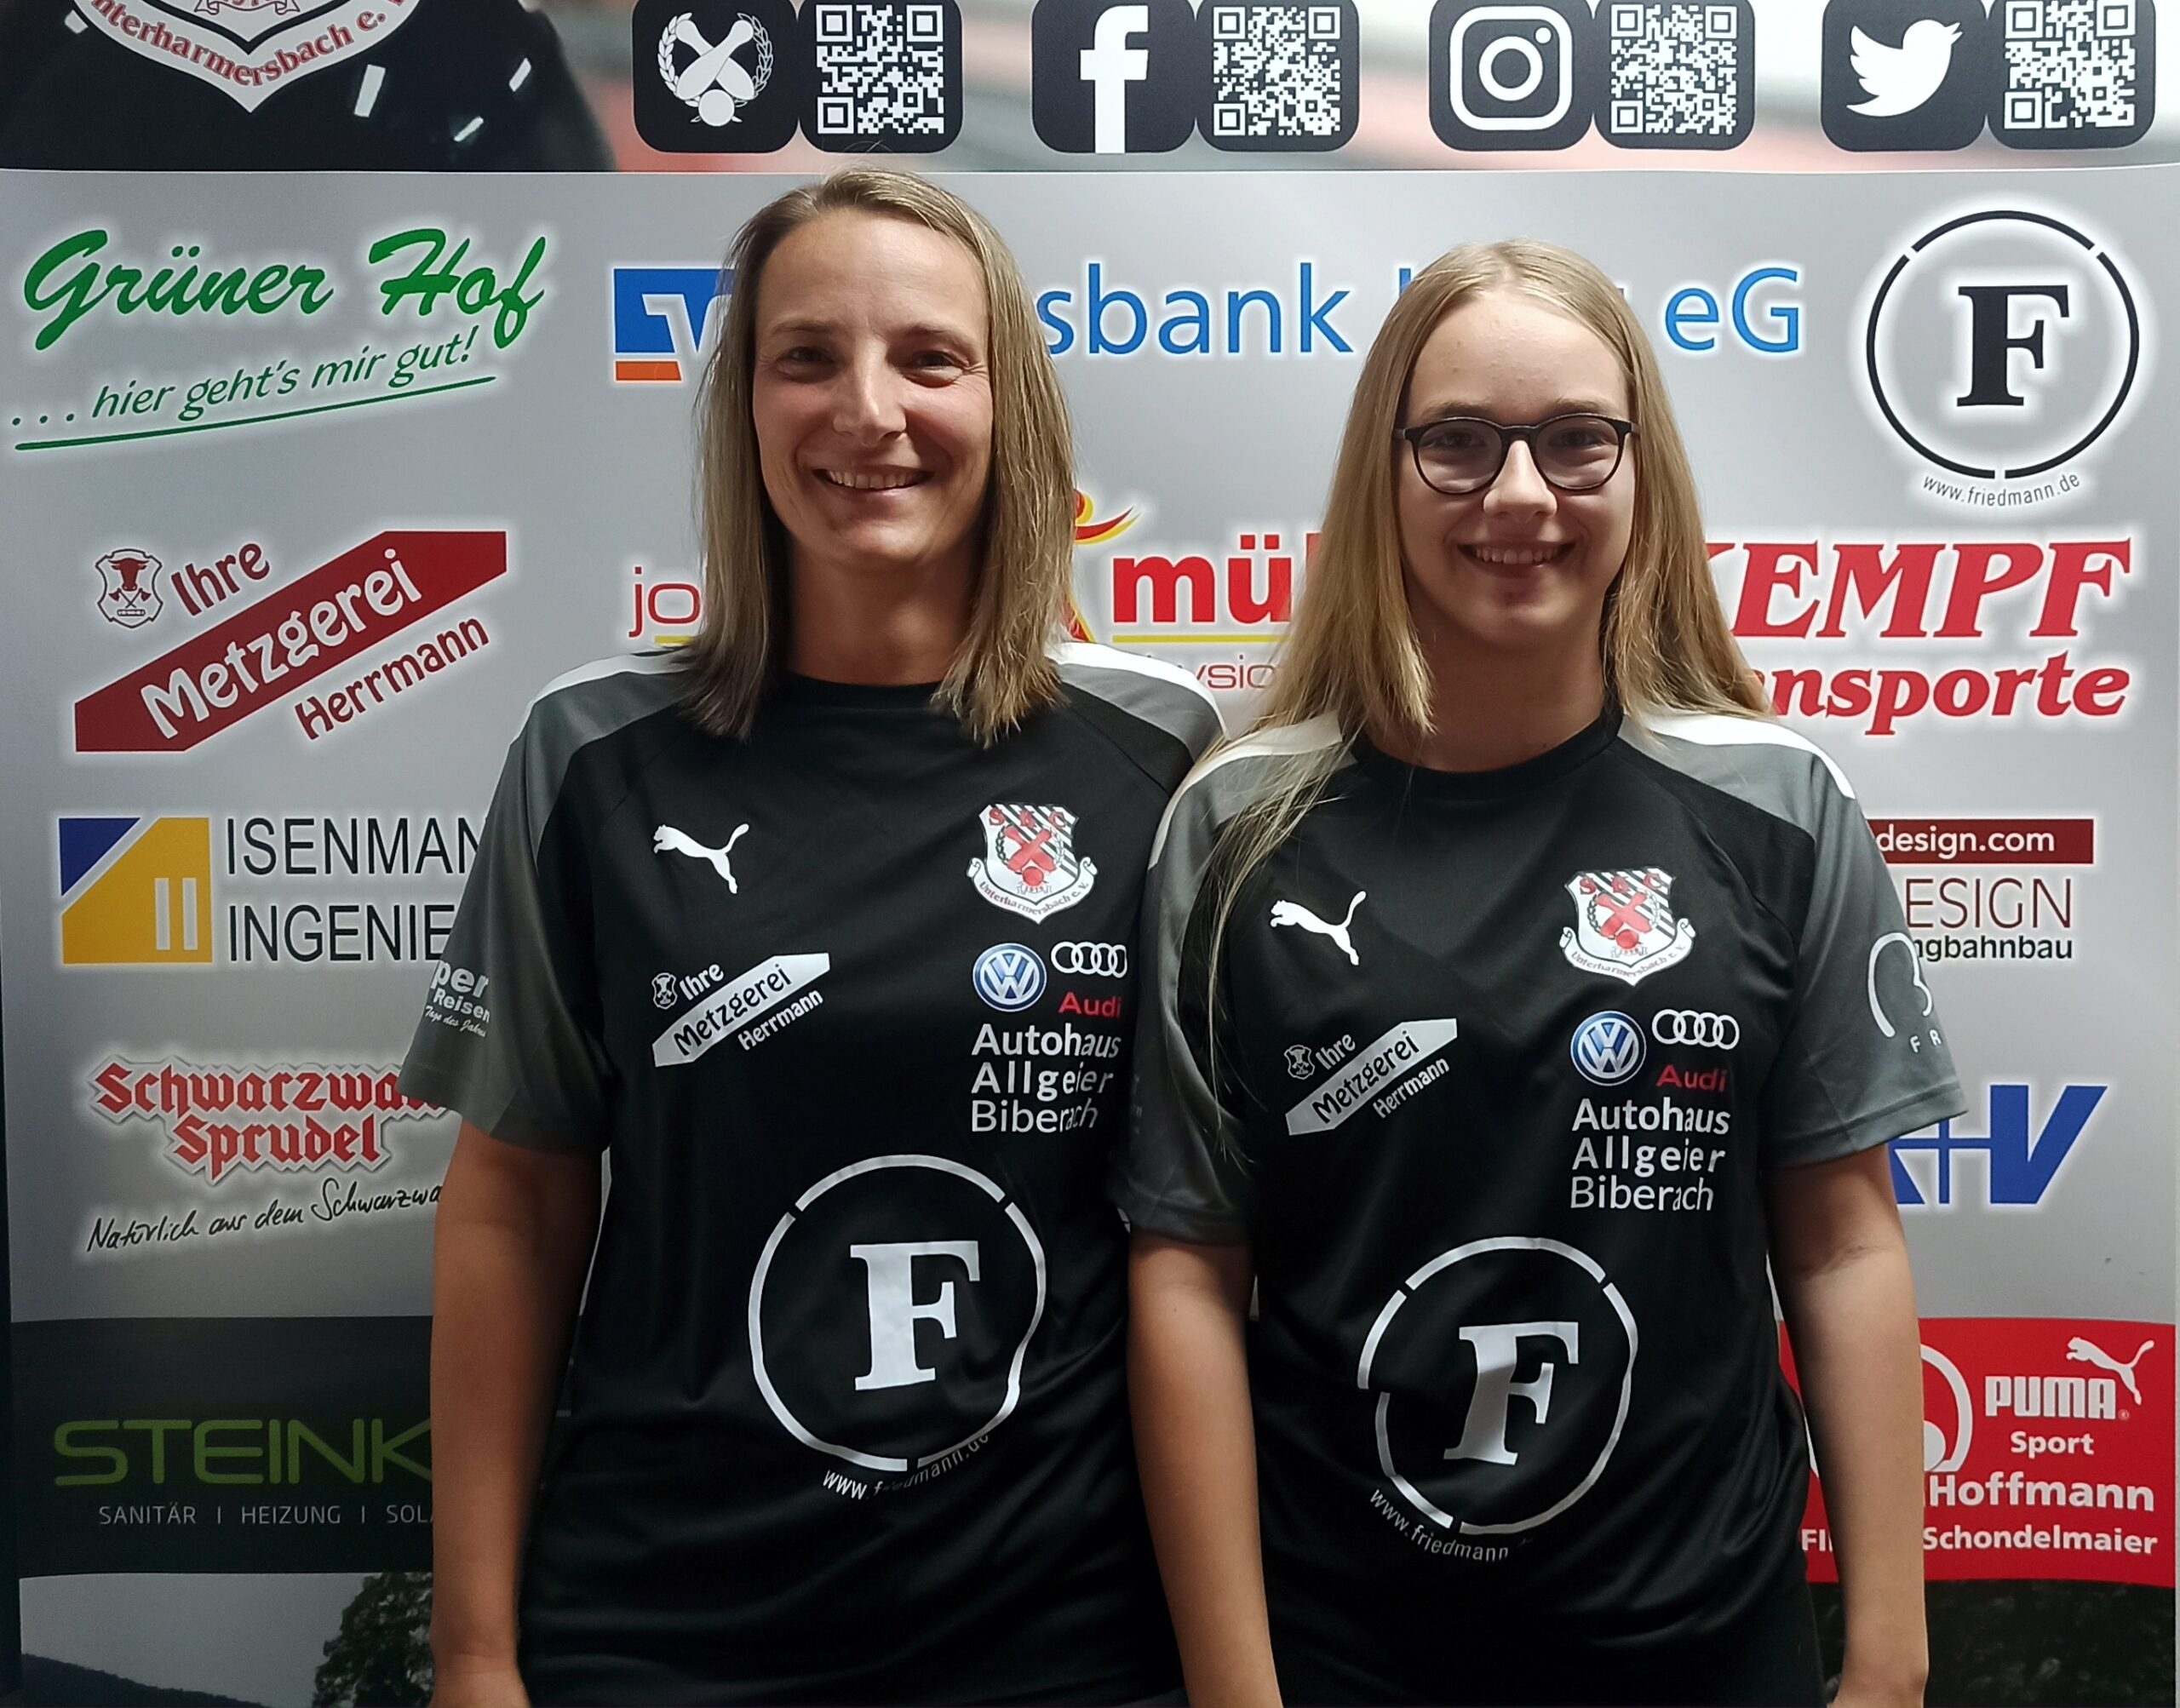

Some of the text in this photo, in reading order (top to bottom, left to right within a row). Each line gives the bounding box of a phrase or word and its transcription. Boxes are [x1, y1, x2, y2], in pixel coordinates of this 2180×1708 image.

[356, 11, 387, 32] e.
[24, 228, 546, 350] Grüner Hof
[1036, 263, 1801, 354] sbank eG
[1957, 284, 2070, 408] F
[92, 381, 175, 419] hier
[178, 360, 297, 421] geht's
[311, 345, 385, 390] mir
[388, 325, 479, 387] gut!
[1923, 473, 2080, 507] www.friedmann.de
[170, 543, 271, 616] Ihre
[1112, 533, 1320, 625] mü
[141, 547, 422, 739] Metzgerei
[295, 617, 490, 741] Herrmann
[1751, 650, 2131, 736] nsporte
[1875, 823, 2056, 860] design.com
[1906, 879, 2072, 929] ESIGN
[229, 904, 456, 962] INGENIE
[433, 988, 490, 1023] Reisen
[680, 964, 725, 1001] Ihre
[1058, 991, 1122, 1018] Audi
[674, 964, 793, 1057] Metzgerei
[737, 989, 824, 1052] Herrmann
[972, 1023, 1122, 1058] Autohaus
[1315, 1034, 1357, 1070] Ihre
[95, 1063, 443, 1119] Schwarzwa
[972, 1060, 1114, 1102] Allgeier
[1311, 1030, 1420, 1124] Metzgerei
[1372, 1057, 1450, 1119] Herrmann
[1656, 1064, 1728, 1093] Audi
[972, 1098, 1099, 1133] Biberach
[1571, 1097, 1731, 1135] Autohaus
[172, 1115, 382, 1180] Sprudel
[1572, 1135, 1726, 1178] Allgeier
[1570, 1174, 1714, 1212] Biberach
[87, 1211, 200, 1252] Natürlich
[209, 1215, 247, 1236] aus
[255, 1199, 305, 1227] dem
[850, 1240, 981, 1391] F
[1443, 1321, 1579, 1466] F
[54, 1418, 433, 1486] STEINK
[2010, 1431, 2095, 1459] Sport
[98, 1502, 197, 1525] SANITÄR
[241, 1505, 341, 1524] HEIZUNG
[385, 1505, 433, 1524] SOL
[1928, 1471, 2155, 1512] Hoffmann
[1800, 1524, 2159, 1555] FI Schondelmaier
